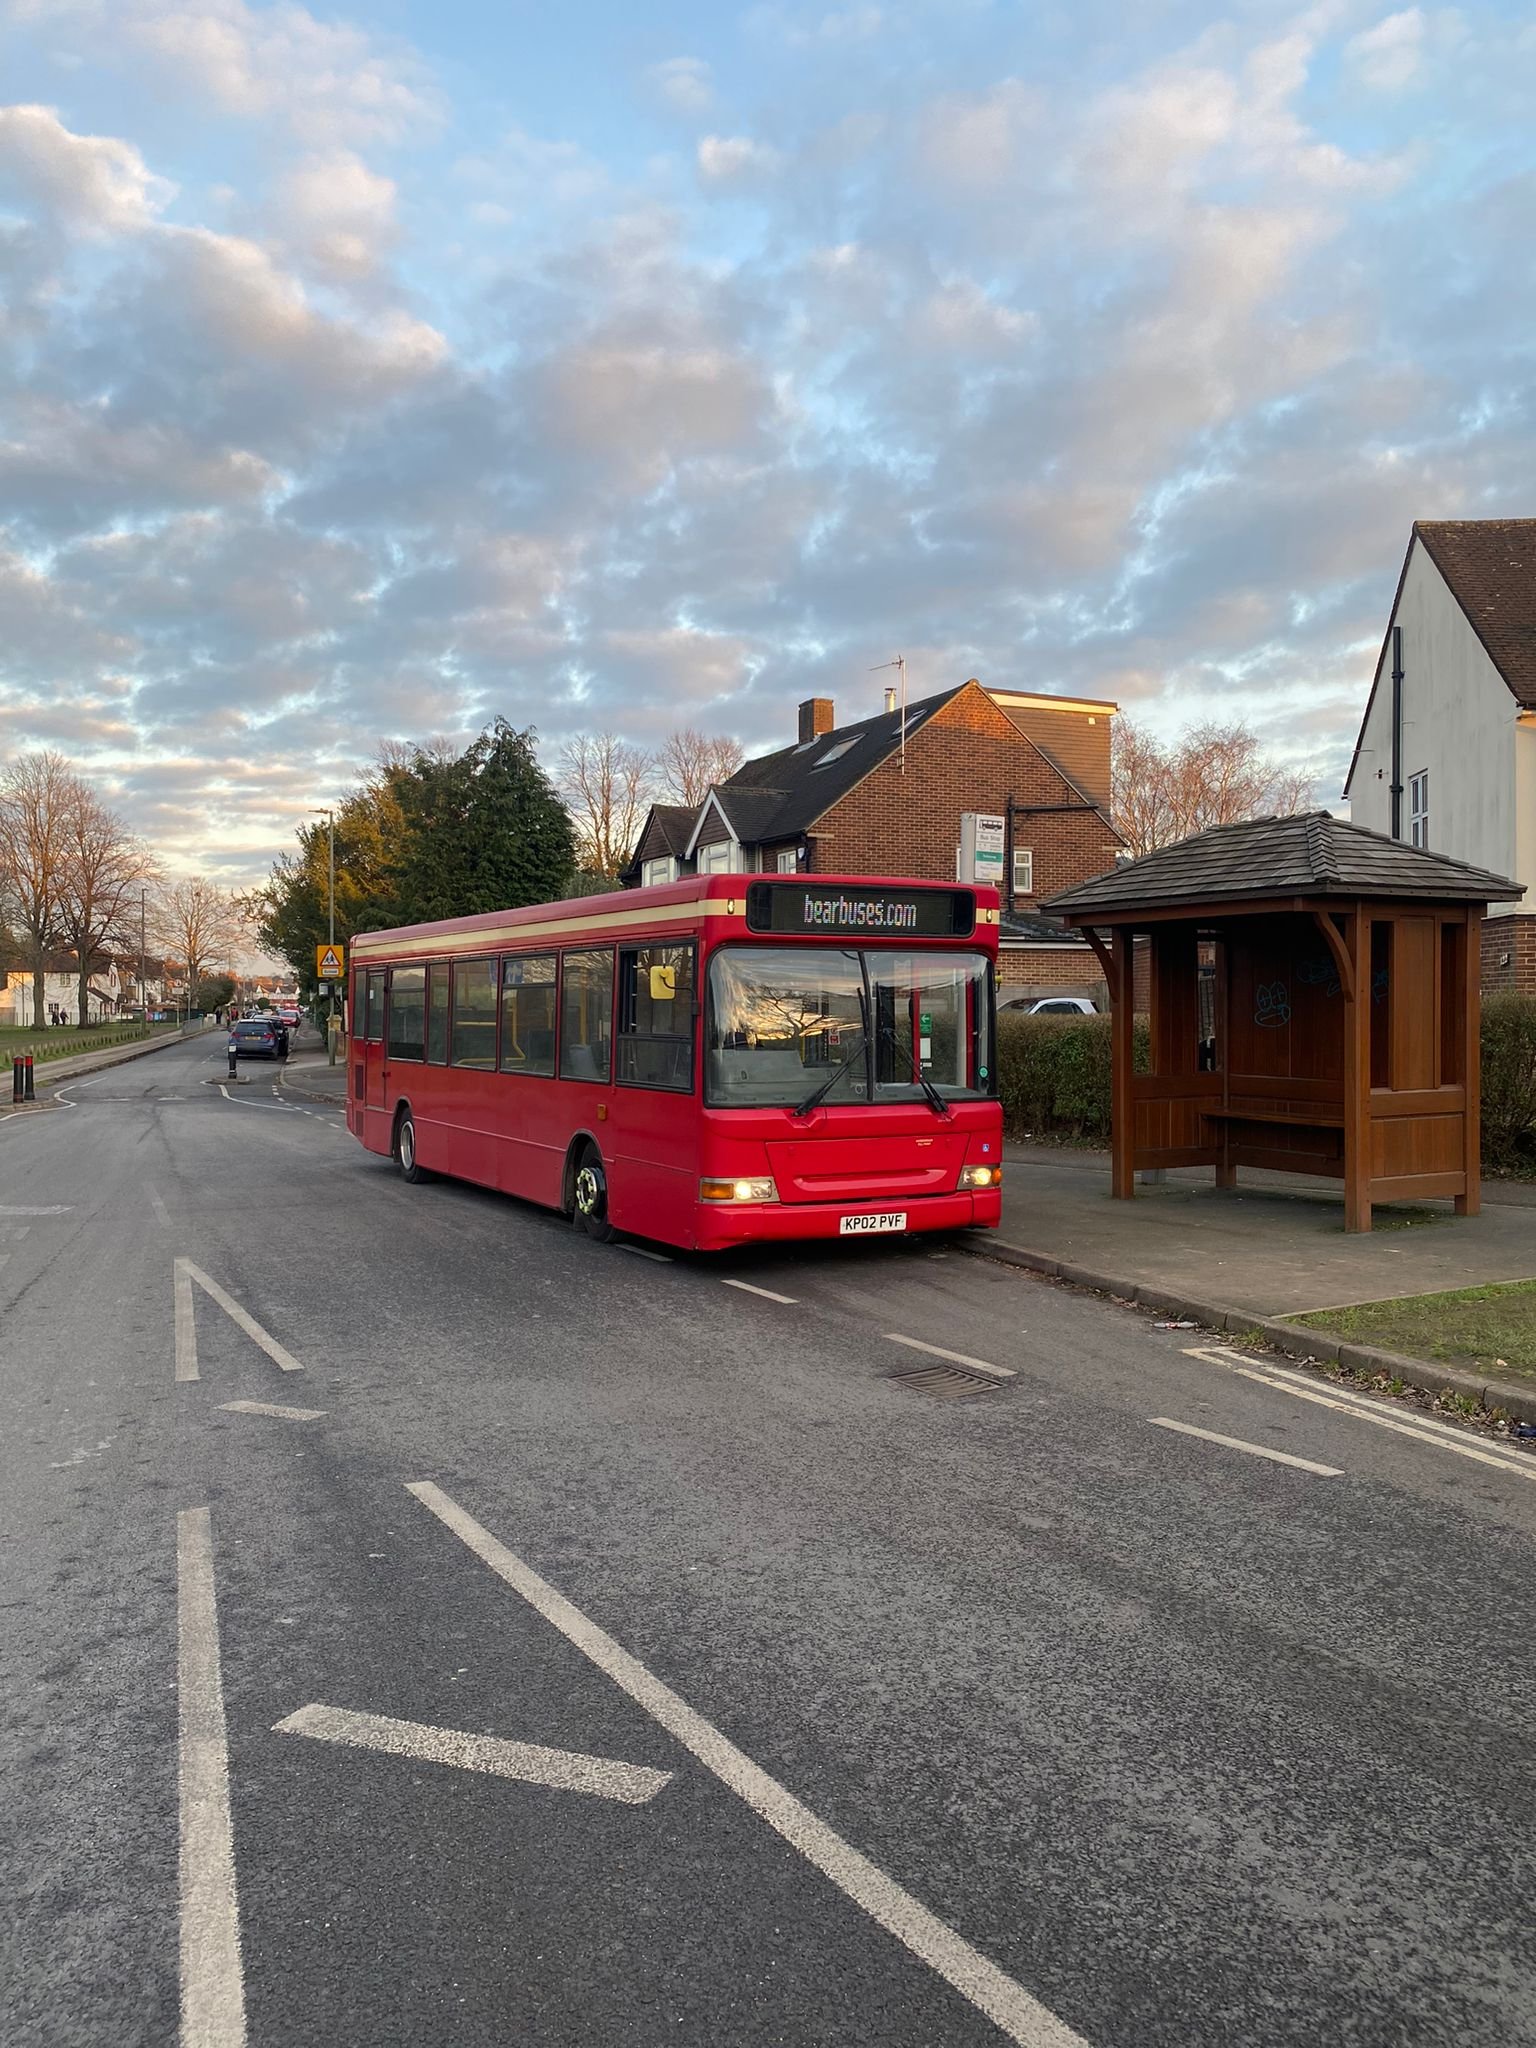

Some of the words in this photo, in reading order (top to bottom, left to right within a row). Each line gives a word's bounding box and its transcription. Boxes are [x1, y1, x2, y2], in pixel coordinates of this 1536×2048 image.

[804, 894, 917, 927] bearbuses.com
[845, 1216, 876, 1231] KP02
[879, 1214, 902, 1228] PVF
